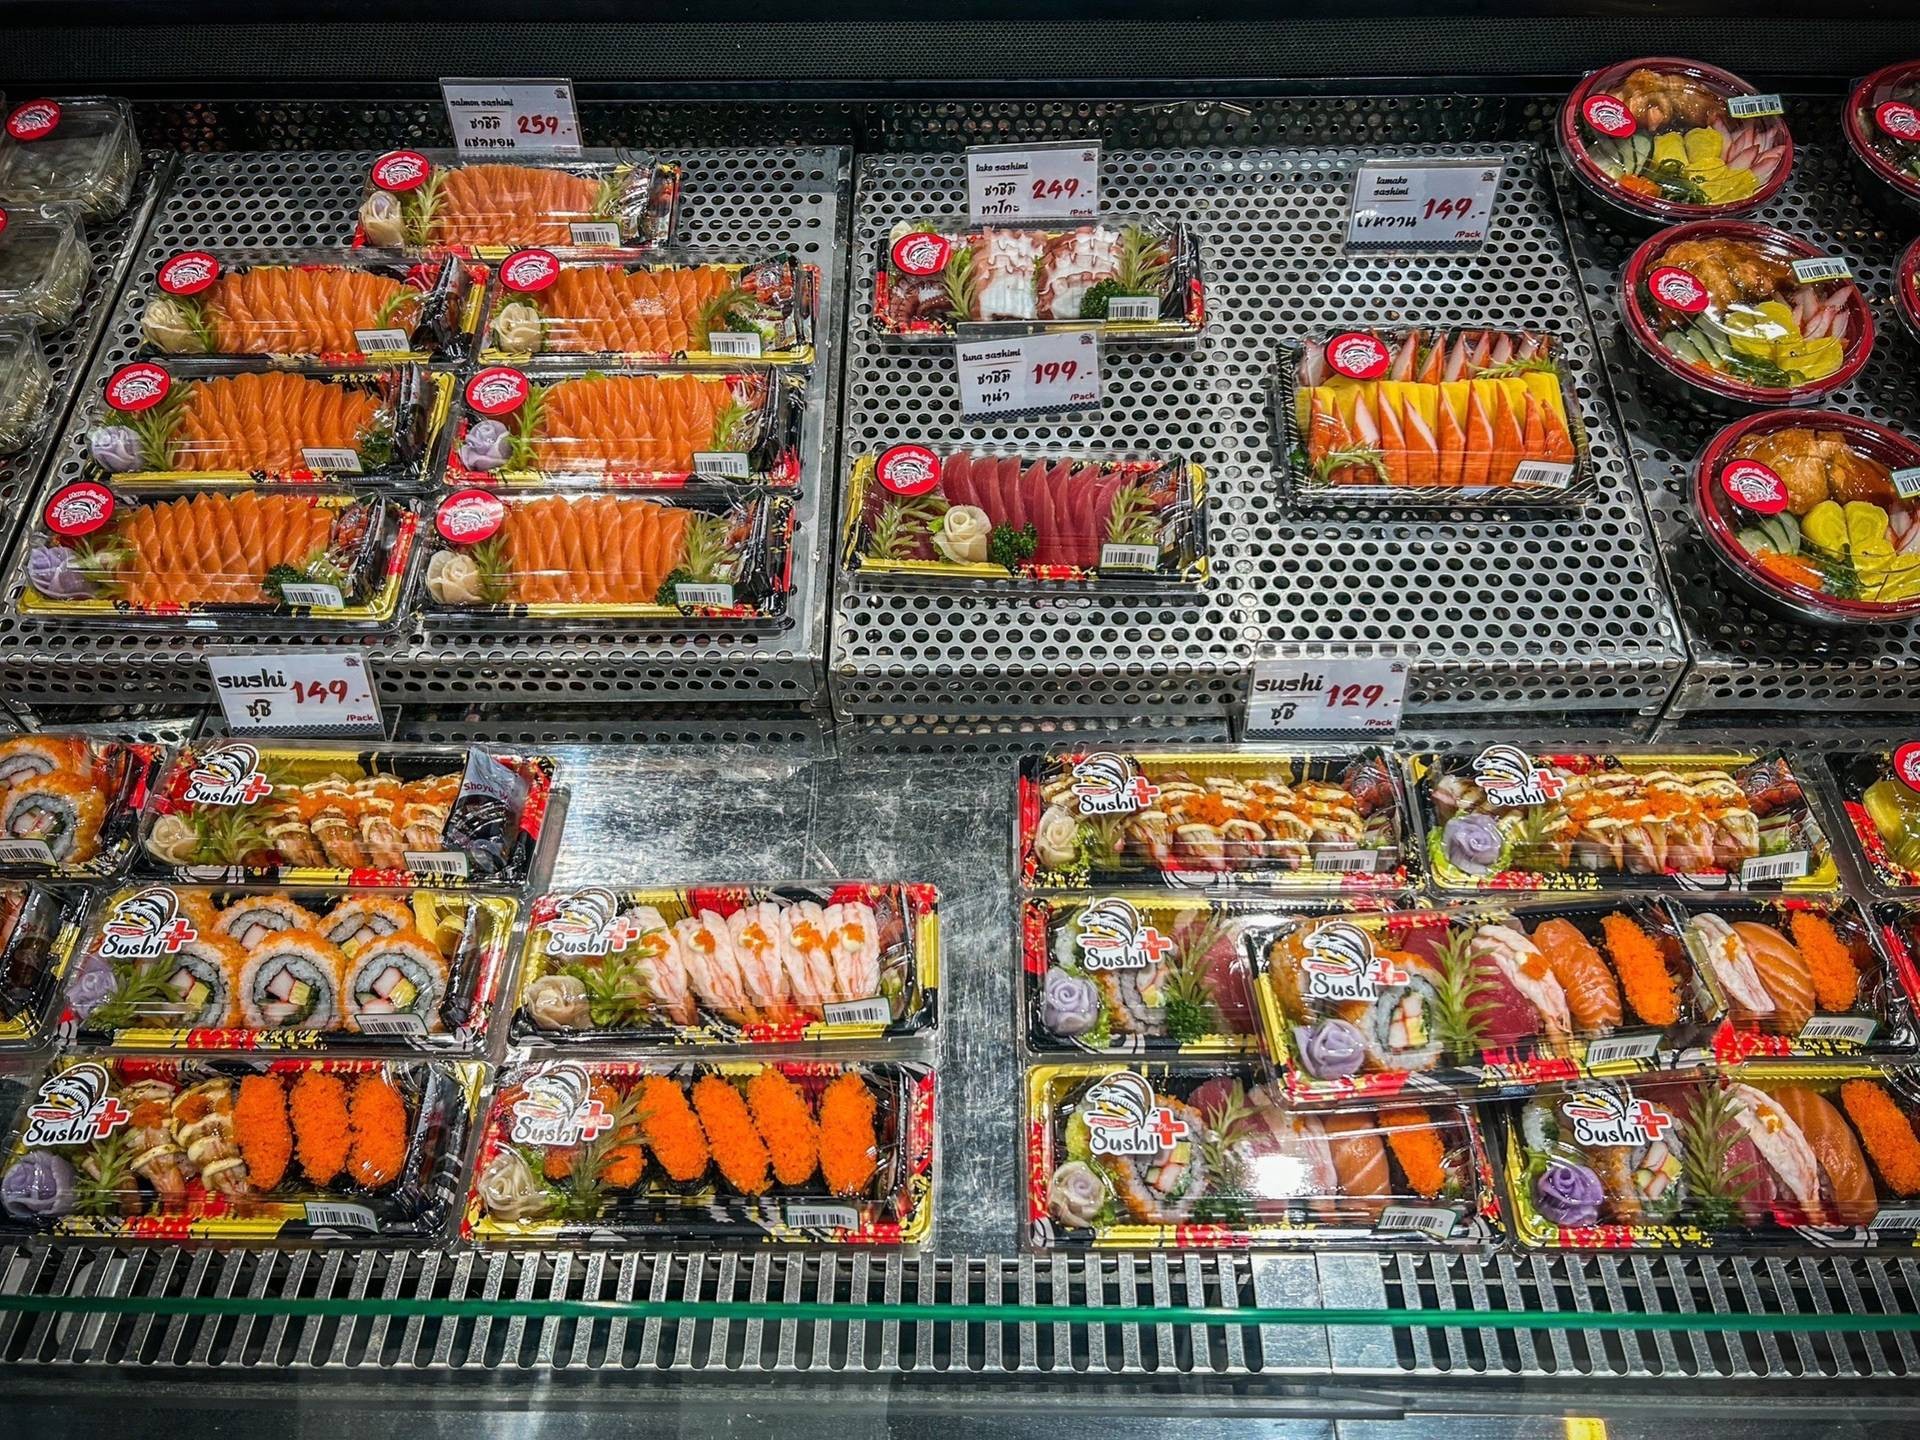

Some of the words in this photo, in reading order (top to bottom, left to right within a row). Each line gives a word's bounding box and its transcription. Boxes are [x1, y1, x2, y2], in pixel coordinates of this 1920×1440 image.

[975, 164, 993, 172] tako
[994, 162, 1029, 172] sashimi
[1373, 187, 1410, 196] sashimi
[1454, 230, 1481, 239] /Pack
[962, 352, 984, 362] tuna
[985, 348, 1023, 361] sashimi
[1069, 392, 1096, 402] /Pack
[217, 667, 288, 689] sushi
[1254, 672, 1325, 693] sushi
[346, 714, 375, 722] /Pack
[1364, 719, 1394, 727] /Pack
[185, 781, 242, 804] Sushi
[1080, 792, 1135, 813] Sushi
[1487, 785, 1543, 806] Sushi
[102, 934, 163, 956] Sushi
[549, 931, 608, 954] Sushi
[1086, 945, 1144, 969] Sushi
[1313, 971, 1377, 997] Sushi
[25, 1117, 92, 1143] Sushi
[515, 1115, 578, 1142] Sushi
[1091, 1125, 1156, 1151] Sushi
[1576, 1117, 1642, 1143] Sushi
